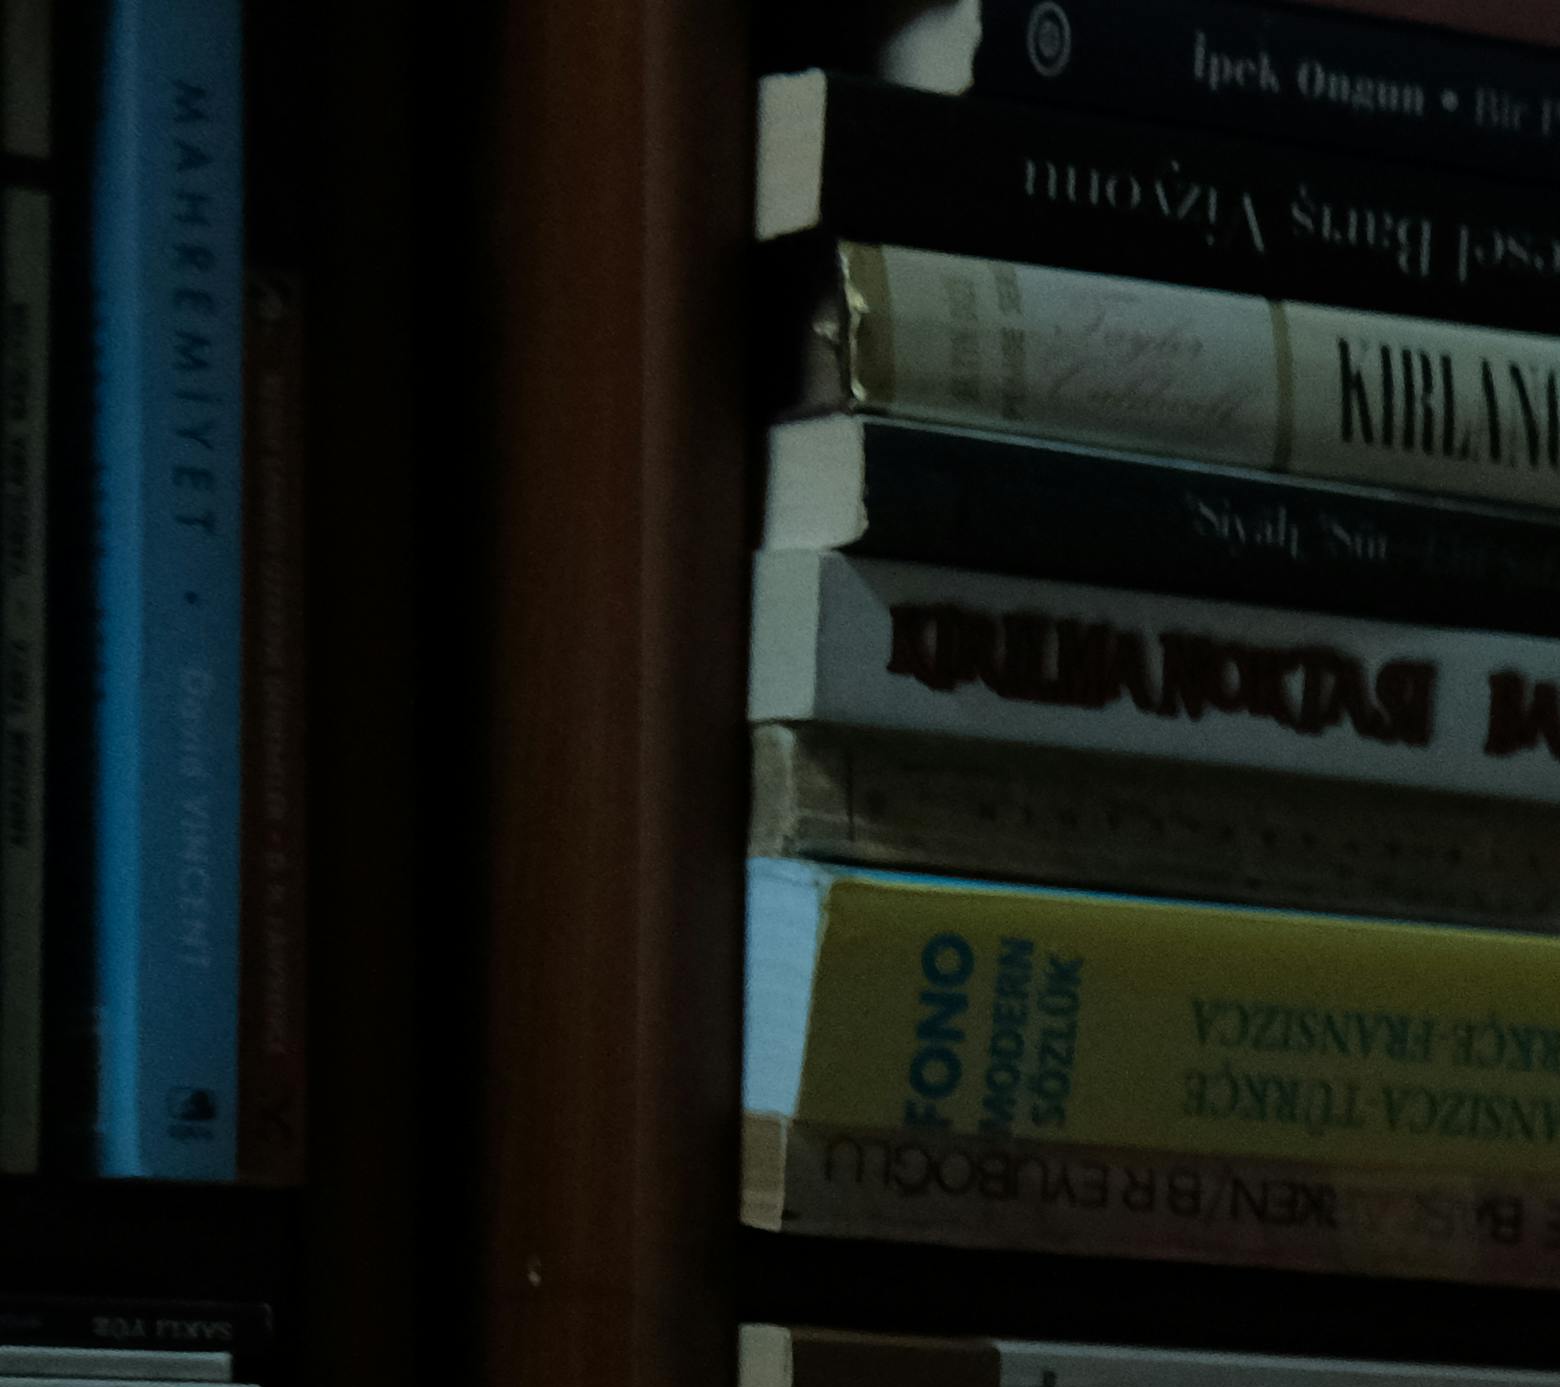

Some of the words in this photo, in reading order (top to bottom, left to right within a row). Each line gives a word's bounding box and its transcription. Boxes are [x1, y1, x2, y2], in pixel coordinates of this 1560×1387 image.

[1298, 59, 1426, 116] Ongun
[1022, 145, 1266, 258] Vizyonu
[1290, 184, 1433, 282] Barış
[167, 79, 216, 538] MAHREMİYET
[904, 931, 974, 1128] FONO
[979, 936, 1035, 1139] MODERN
[1027, 953, 1085, 1129] SÖZLÜK
